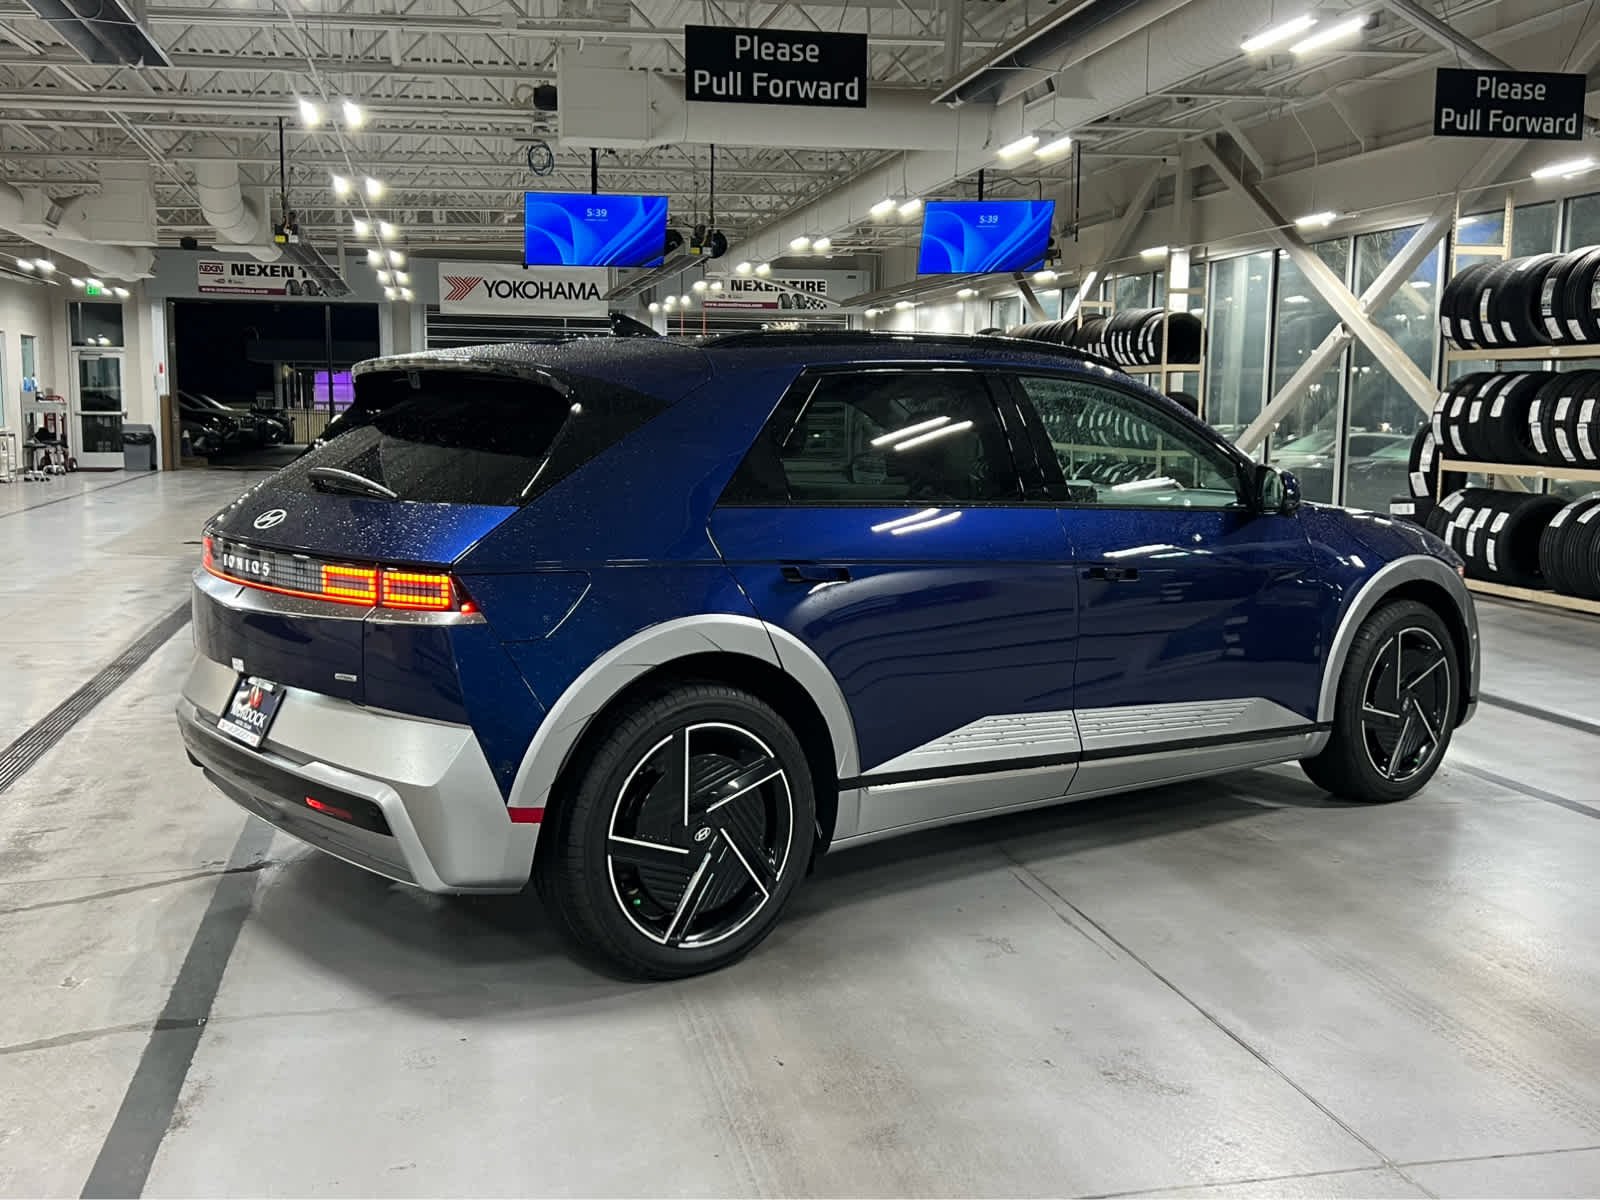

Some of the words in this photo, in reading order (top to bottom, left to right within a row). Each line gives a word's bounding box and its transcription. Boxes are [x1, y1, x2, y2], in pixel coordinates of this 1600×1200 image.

[735, 34, 820, 63] Please
[694, 69, 742, 96] Pull
[752, 72, 859, 101] Forward
[1476, 76, 1547, 100] Please
[1440, 107, 1481, 131] Pull
[1488, 109, 1577, 135] Forward
[586, 207, 608, 217] 5:39
[231, 263, 294, 278] NEXEN
[483, 279, 601, 300] YOKOHAMA
